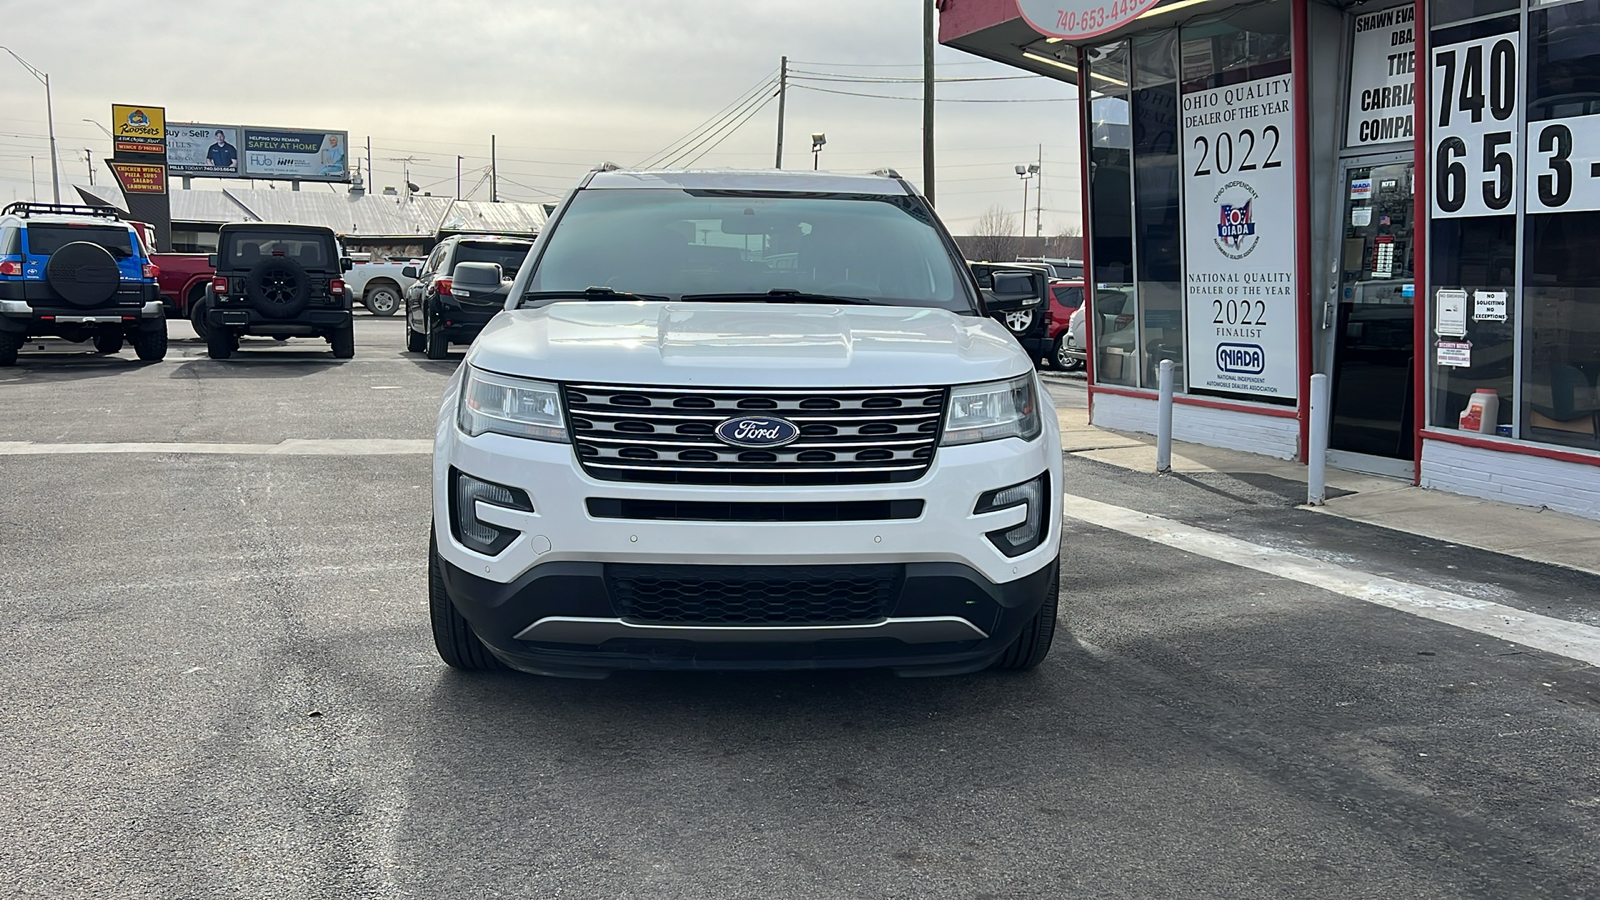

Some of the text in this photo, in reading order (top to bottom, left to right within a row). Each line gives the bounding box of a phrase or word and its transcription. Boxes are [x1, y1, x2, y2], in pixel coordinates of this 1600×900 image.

[1055, 0, 1145, 32] 740-653-445
[1356, 9, 1393, 33] SHAWN
[1387, 50, 1415, 77] THE
[1435, 38, 1516, 128] 740
[1183, 78, 1291, 111] OHIO QUALITY
[1185, 99, 1290, 129] DEALER OF THE YEAR
[119, 123, 160, 136] Roosters
[189, 129, 210, 138] Sell?
[1359, 114, 1415, 142] COMPA
[248, 141, 279, 149] SAFELY
[292, 143, 318, 151] HOME
[1193, 124, 1282, 177] 2022
[1213, 180, 1260, 204] OHIO INDEPENDENT
[1221, 224, 1249, 236] OIADA
[1188, 272, 1293, 284] NATIONAL QUALITY
[1189, 286, 1291, 295] DEALER OF THE YEAR
[1212, 299, 1267, 326] 2022
[1216, 327, 1262, 338] FINALIST
[1219, 348, 1260, 369] NIADA
[1206, 380, 1278, 393] AUTOMOBILE DEALERS ASSOCIATION
[734, 420, 780, 439] Ford
